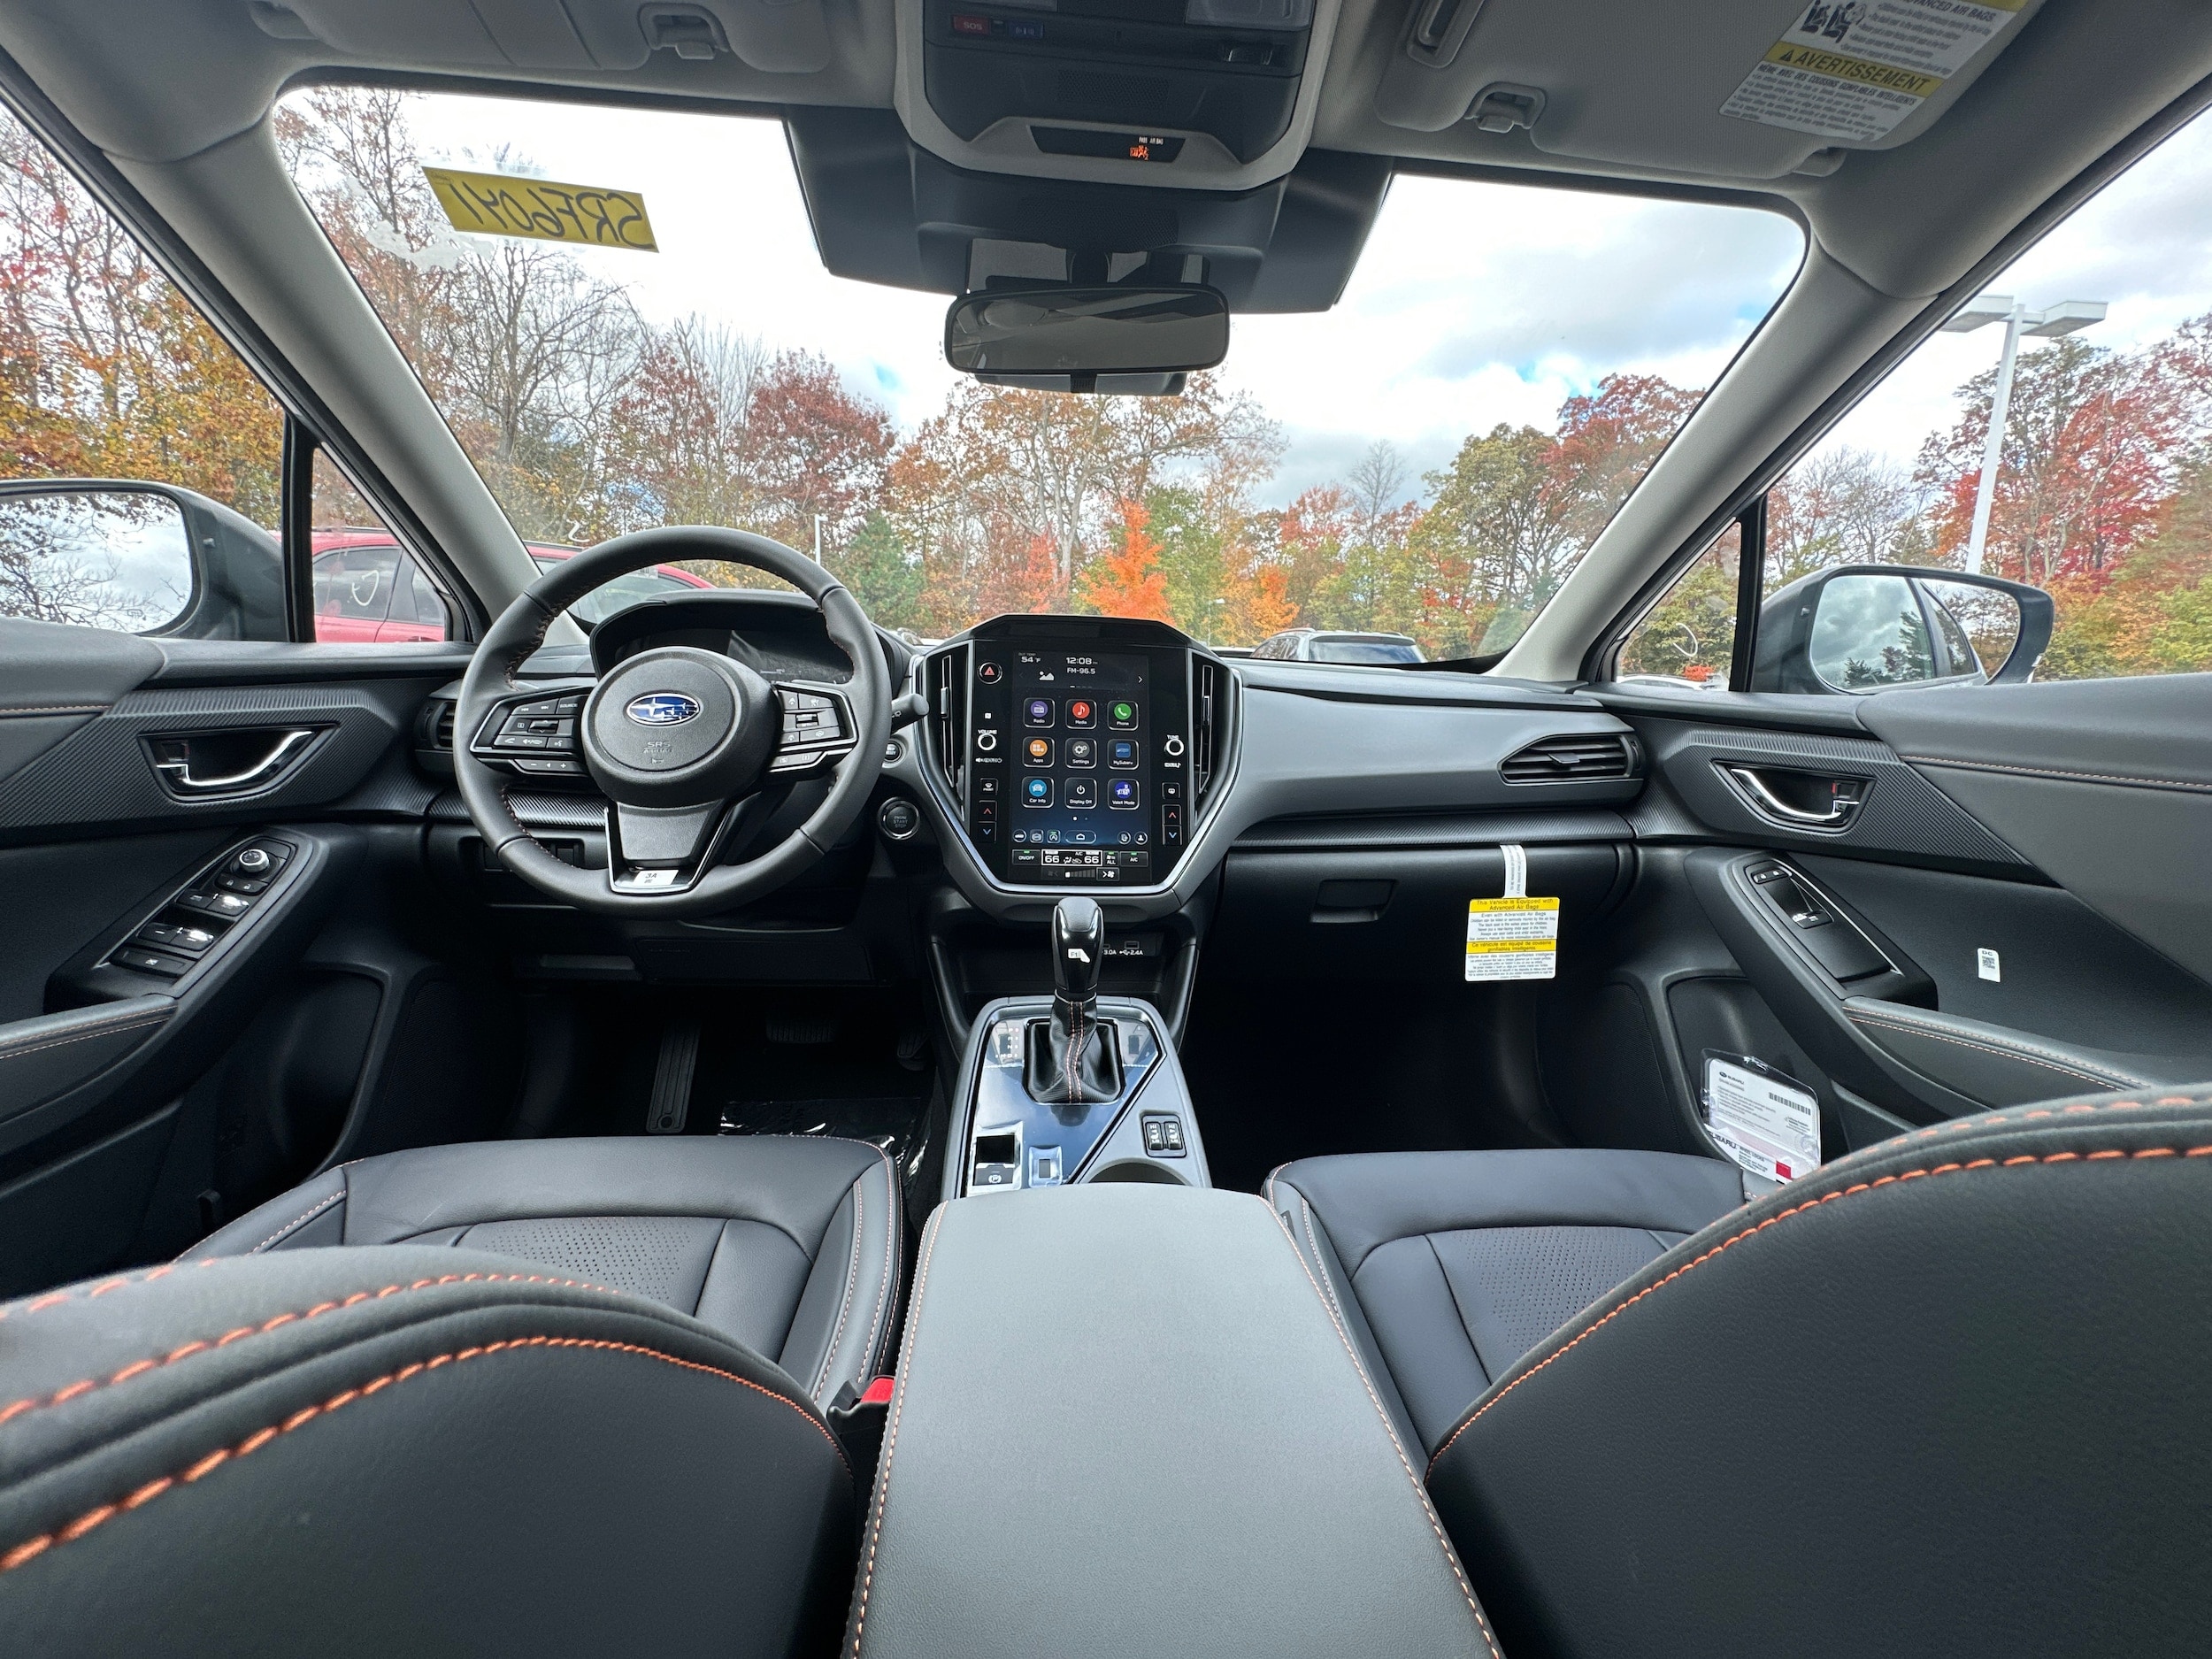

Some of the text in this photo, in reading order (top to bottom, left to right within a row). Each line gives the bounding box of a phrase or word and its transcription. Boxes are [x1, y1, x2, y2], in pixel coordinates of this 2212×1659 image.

[1949, 4, 1970, 15] AIR
[1967, 8, 1997, 22] BAGS
[964, 22, 983, 31] SOS
[1794, 50, 1932, 92] AVERTISSEMENT
[1793, 72, 1807, 81] DES
[1066, 657, 1092, 665] 12:08
